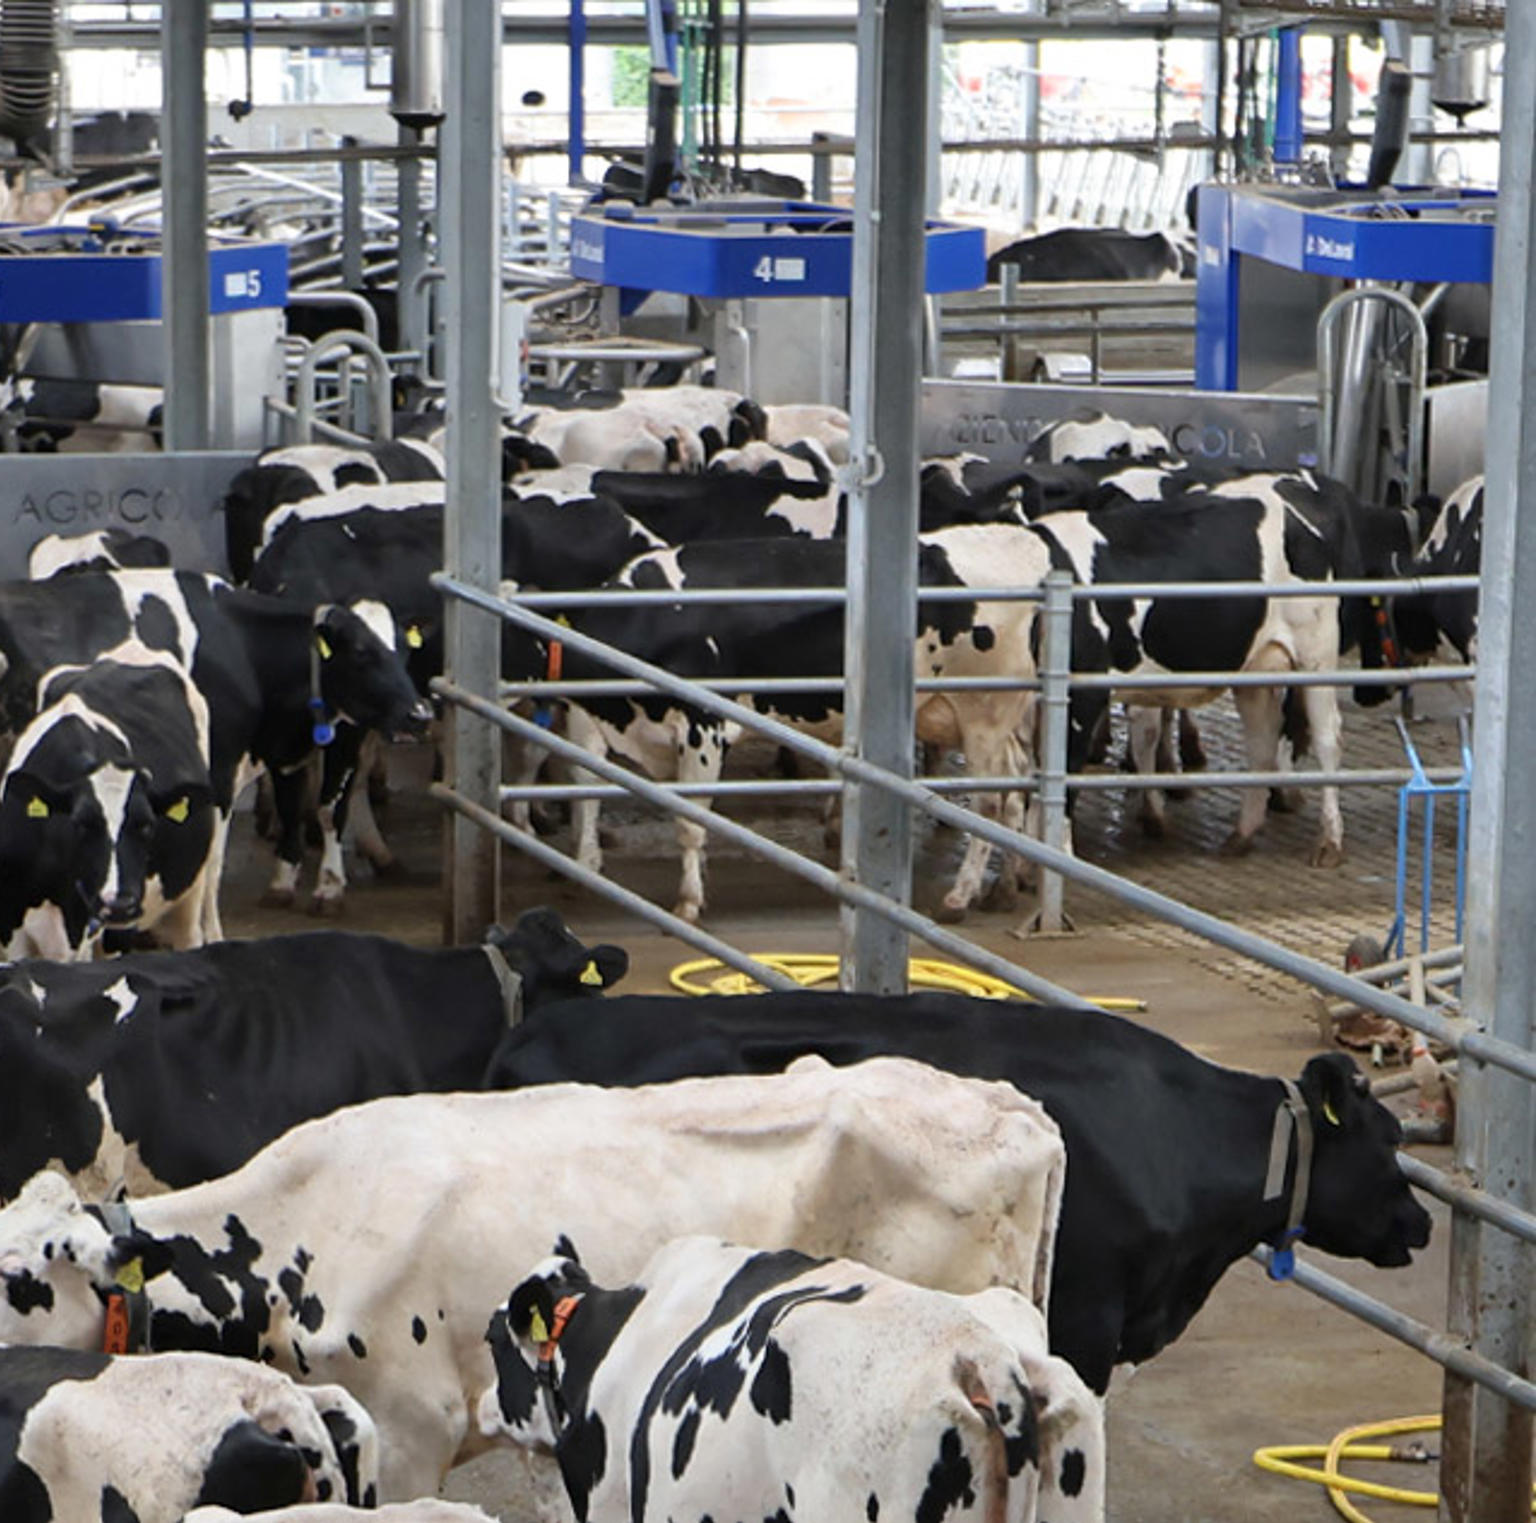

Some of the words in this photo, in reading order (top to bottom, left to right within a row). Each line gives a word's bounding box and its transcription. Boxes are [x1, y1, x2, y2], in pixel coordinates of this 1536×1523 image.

[247, 269, 262, 298] 5
[753, 256, 774, 283] 4
[13, 487, 226, 525] AGRICO
